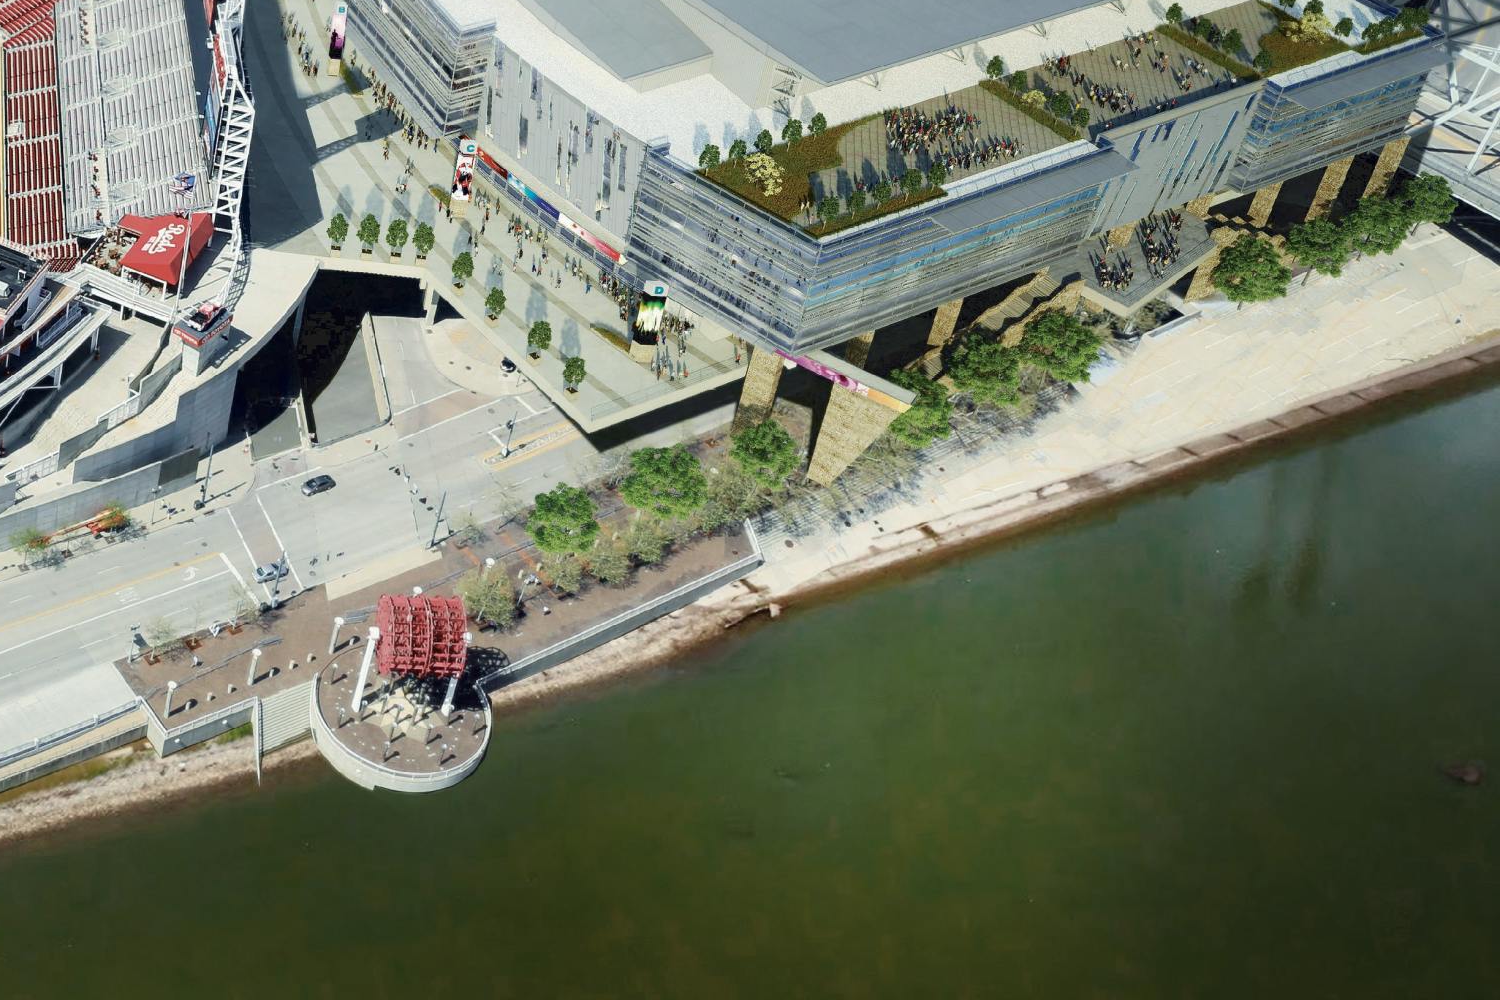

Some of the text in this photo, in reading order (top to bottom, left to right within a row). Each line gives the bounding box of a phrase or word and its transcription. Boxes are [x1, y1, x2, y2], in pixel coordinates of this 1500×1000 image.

[466, 144, 475, 153] C
[148, 224, 185, 254] Reds
[654, 286, 664, 294] D
